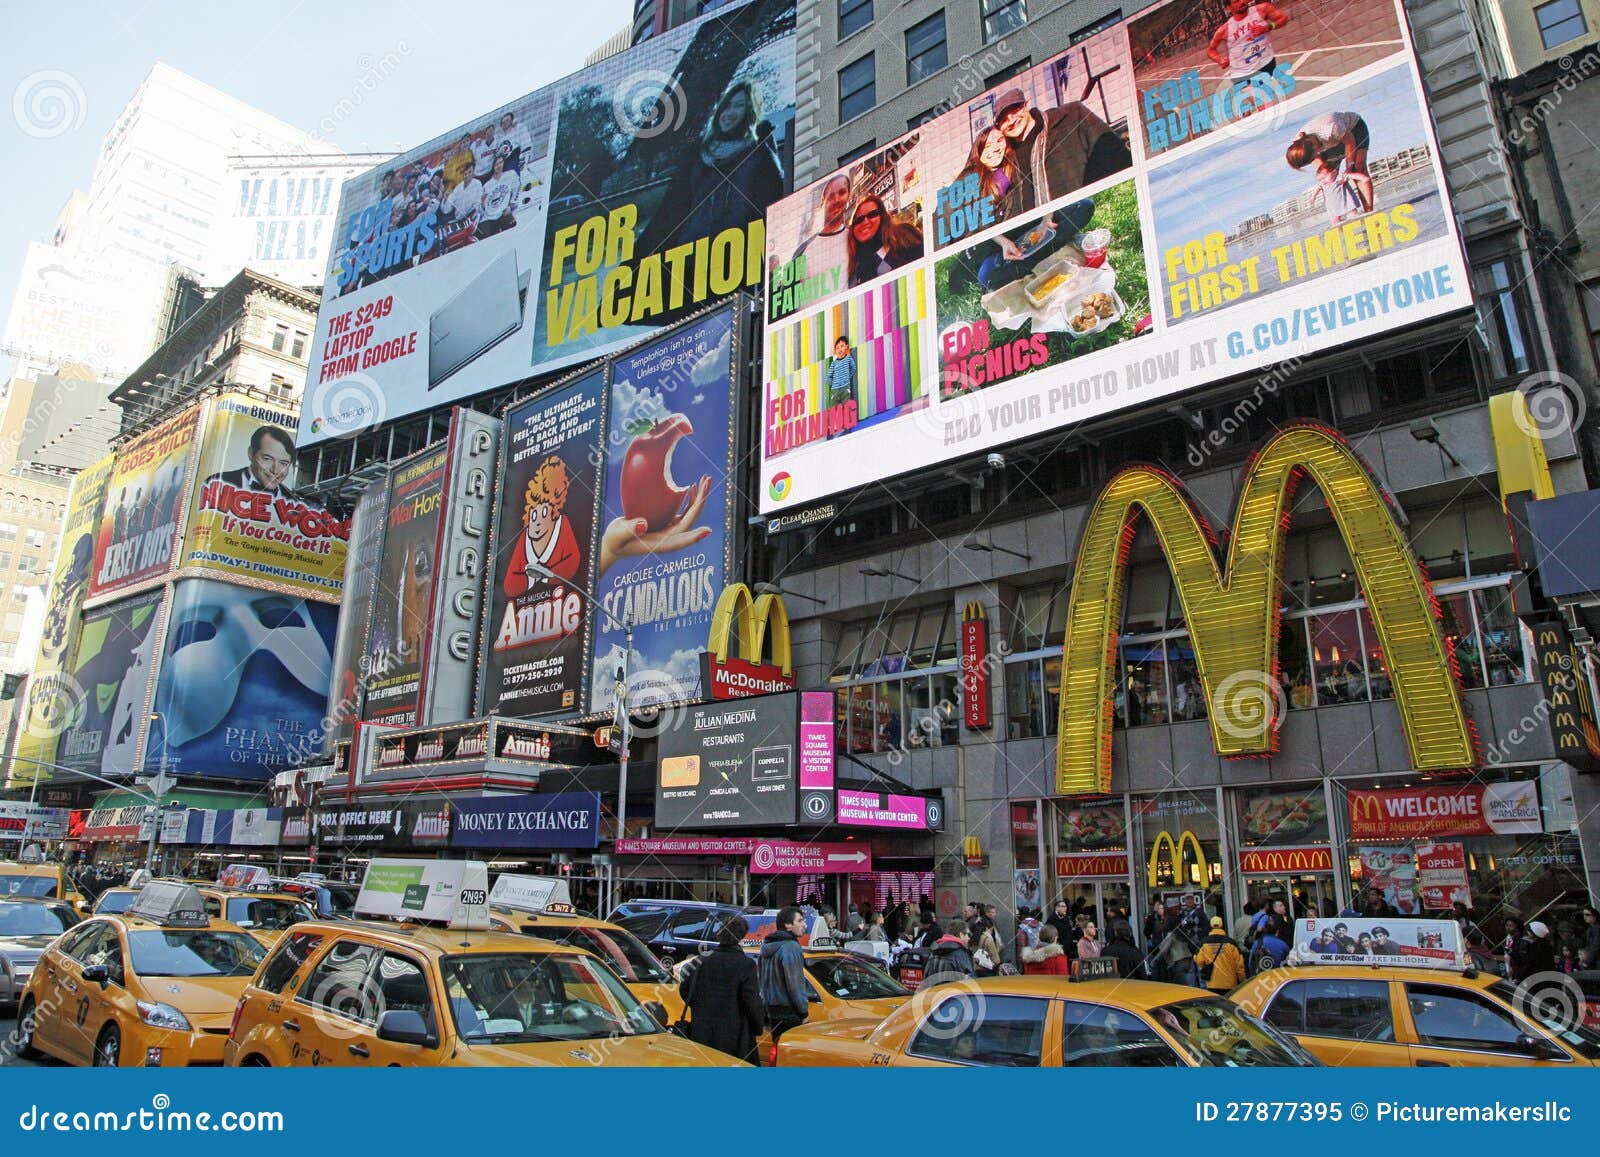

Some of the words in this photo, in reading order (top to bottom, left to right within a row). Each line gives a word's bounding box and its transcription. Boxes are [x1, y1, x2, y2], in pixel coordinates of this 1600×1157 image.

[1142, 69, 1202, 120] FOR
[1148, 62, 1297, 151] RUNNERS
[936, 172, 981, 216] FOR
[345, 200, 394, 243] FOR
[938, 195, 996, 245] LOVE
[337, 213, 437, 286] SPORTS
[549, 203, 638, 288] FOR
[1165, 232, 1227, 283] FOR
[773, 256, 807, 288] FOR
[1169, 256, 1260, 319] FIRST
[1272, 204, 1420, 285] TIMERS
[772, 265, 842, 320] FAMILY
[329, 311, 351, 338] THE
[355, 295, 393, 329] $249
[324, 325, 374, 361] LAPTOP
[631, 347, 668, 369] Temptation
[670, 337, 686, 351] isn't
[942, 320, 990, 363] FOR
[944, 413, 981, 446] ADD
[987, 393, 1042, 430] YOUR
[1047, 369, 1118, 414] PHOTO
[1125, 349, 1180, 390] NOW
[1190, 337, 1218, 371] AT
[1226, 264, 1454, 359] G.CO/EVERYONE
[319, 354, 358, 384] FROM
[362, 331, 418, 370] GOOGLE
[637, 365, 660, 380] Unless
[677, 349, 694, 364] give
[943, 333, 1049, 396] PICNICS
[513, 416, 557, 443] FEEL-GOOD
[559, 398, 596, 422] MUSICAL
[544, 393, 583, 418] ULTIMATE
[769, 388, 806, 427] FOR
[158, 429, 194, 455] WILD
[513, 445, 541, 463] BETTER
[543, 434, 565, 450] THAN
[567, 418, 596, 440] EVER!"
[526, 435, 535, 446] IS
[537, 426, 557, 443] BACK
[560, 416, 579, 432] AND
[769, 400, 858, 455] WINNING
[200, 481, 273, 523] NICE
[223, 515, 239, 533] If
[240, 520, 265, 540] You
[266, 527, 292, 547] Can
[292, 535, 318, 553] Get
[318, 540, 331, 554] It
[450, 429, 492, 662] PALACE
[97, 534, 141, 586] JERSEY
[140, 522, 175, 569] BOYS
[294, 553, 324, 566] Musical
[253, 563, 301, 580] FUNNIEST
[301, 573, 327, 585] LOVE
[613, 563, 654, 588] CAROLEE
[654, 552, 706, 578] CARMELLO
[602, 565, 715, 634] SCANDALOUS
[494, 586, 581, 652] Annie
[968, 626, 978, 661] OPEN
[503, 656, 564, 676] TICKETMASTER.COM
[715, 668, 793, 692] McDonald's
[970, 676, 978, 722] HOURS
[276, 718, 304, 732] THE
[385, 713, 405, 725] CENTER
[406, 711, 416, 722] THE
[694, 716, 722, 729] JULIAN
[723, 711, 757, 725] MEDINA
[379, 745, 406, 764] Annie
[415, 742, 444, 761] Annie
[456, 735, 488, 756] Annie
[502, 734, 551, 759] Annie
[702, 733, 744, 746] RESTAURANTS
[803, 749, 831, 757] MUSEUM
[805, 741, 829, 749] SQUARE
[230, 750, 250, 763] OF
[256, 752, 284, 765] THE
[805, 764, 829, 772] CENTER
[840, 808, 868, 820] MUSEUM
[868, 811, 874, 820] &
[874, 811, 897, 821] VISITOR
[897, 812, 918, 822] CENTER
[841, 796, 858, 807] TIMES
[1385, 794, 1480, 818] WELCOME
[1489, 799, 1515, 810] SPIRIT
[1499, 807, 1538, 818] AMERICA
[320, 813, 337, 826] BOX
[341, 811, 366, 826] OFFICE
[368, 810, 393, 825] HERE
[412, 810, 450, 837] Annie
[458, 813, 502, 832] MONEY
[507, 810, 589, 831] EXCHANGE
[1352, 822, 1378, 833] SPIRIT
[1379, 821, 1388, 832] OF
[1389, 820, 1424, 832] AMERICA
[1425, 819, 1481, 832] PERFORMERS
[661, 840, 687, 850] MUSEUM
[687, 840, 700, 850] AND
[700, 840, 723, 851] VISITOR
[723, 840, 747, 851] CENTER
[775, 846, 795, 857] TIMES
[796, 846, 821, 857] SQUARE
[1532, 854, 1577, 865] COFFEE
[775, 858, 800, 867] VISITOR
[800, 858, 825, 867] CENTER
[1427, 859, 1455, 868] OPEN
[462, 891, 484, 904] 2N95
